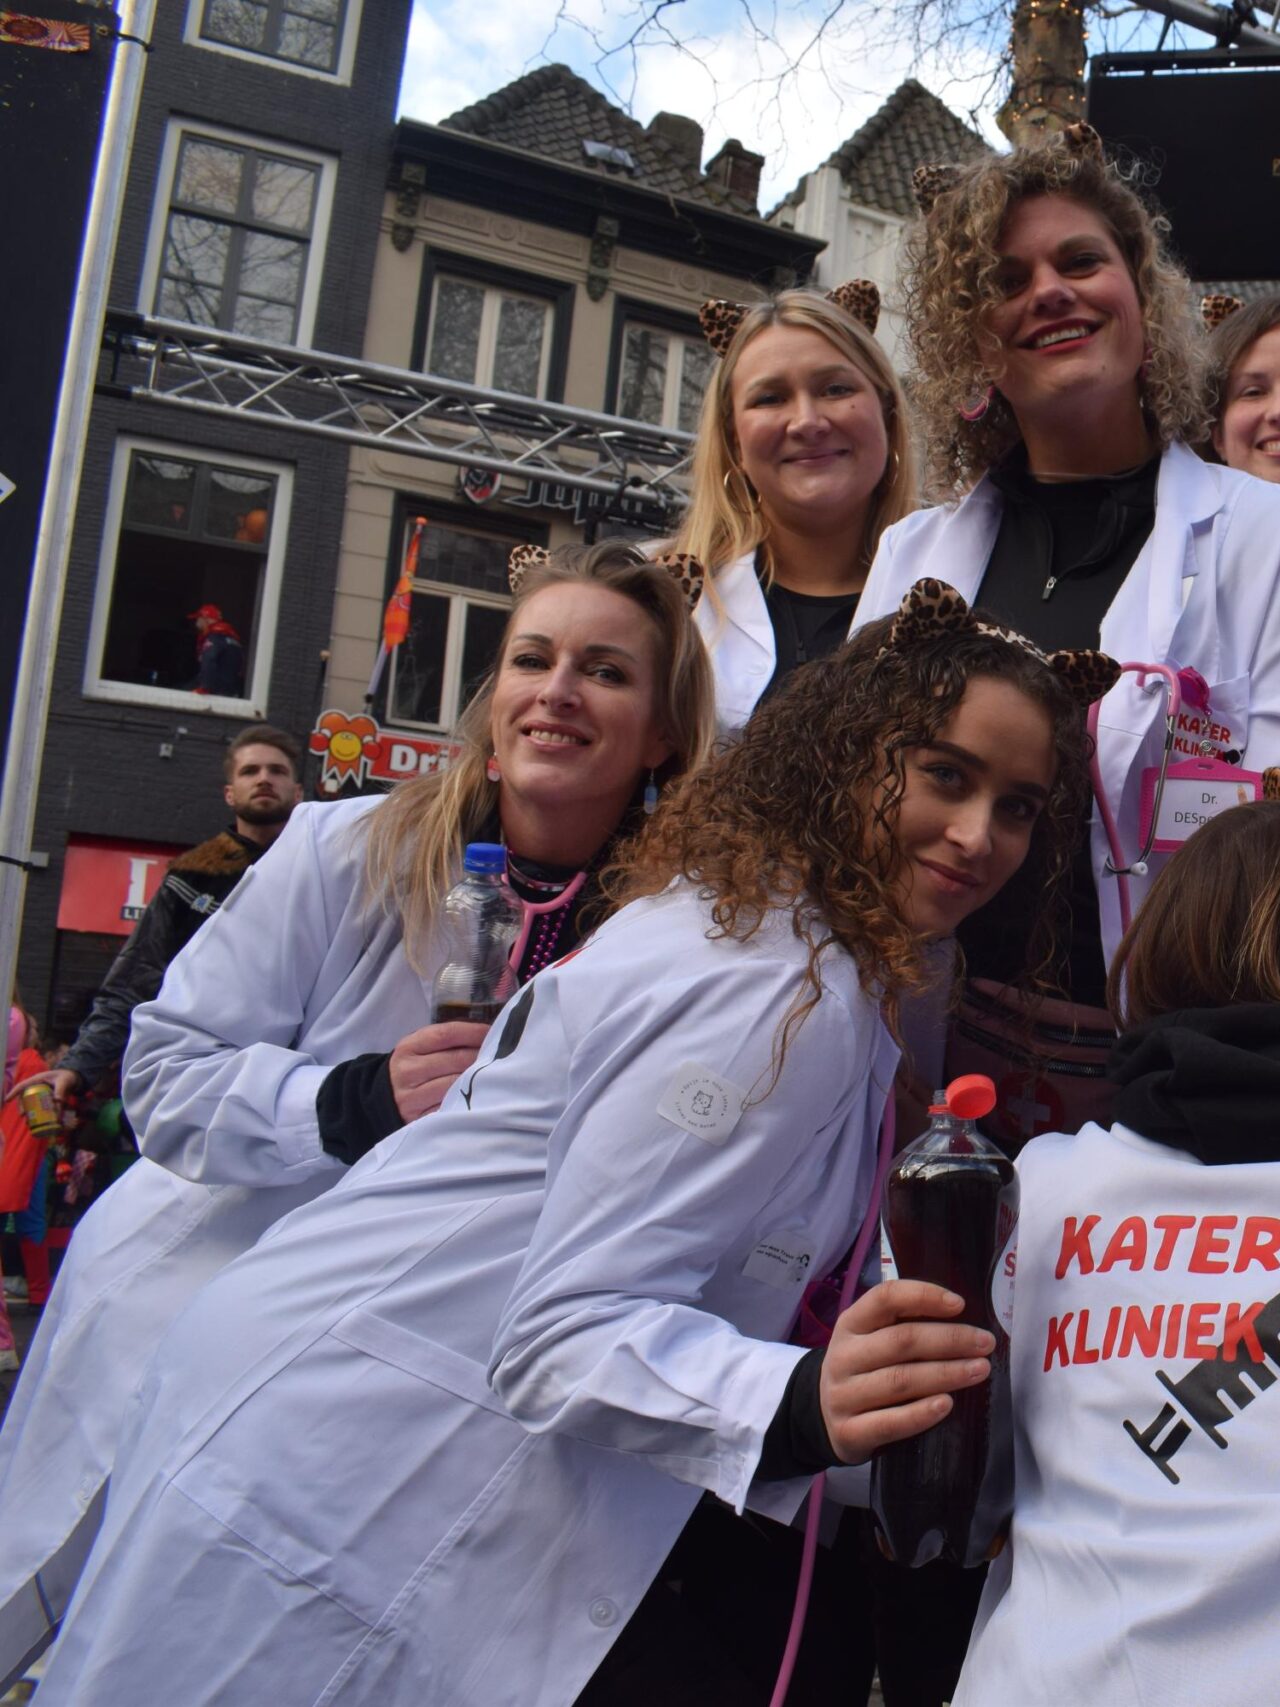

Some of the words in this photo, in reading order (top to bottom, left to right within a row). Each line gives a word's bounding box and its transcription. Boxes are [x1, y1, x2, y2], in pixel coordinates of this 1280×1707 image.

[390, 744, 449, 775] Dri
[1201, 792, 1218, 805] Dr.
[1043, 1300, 1267, 1373] KLINIEK
